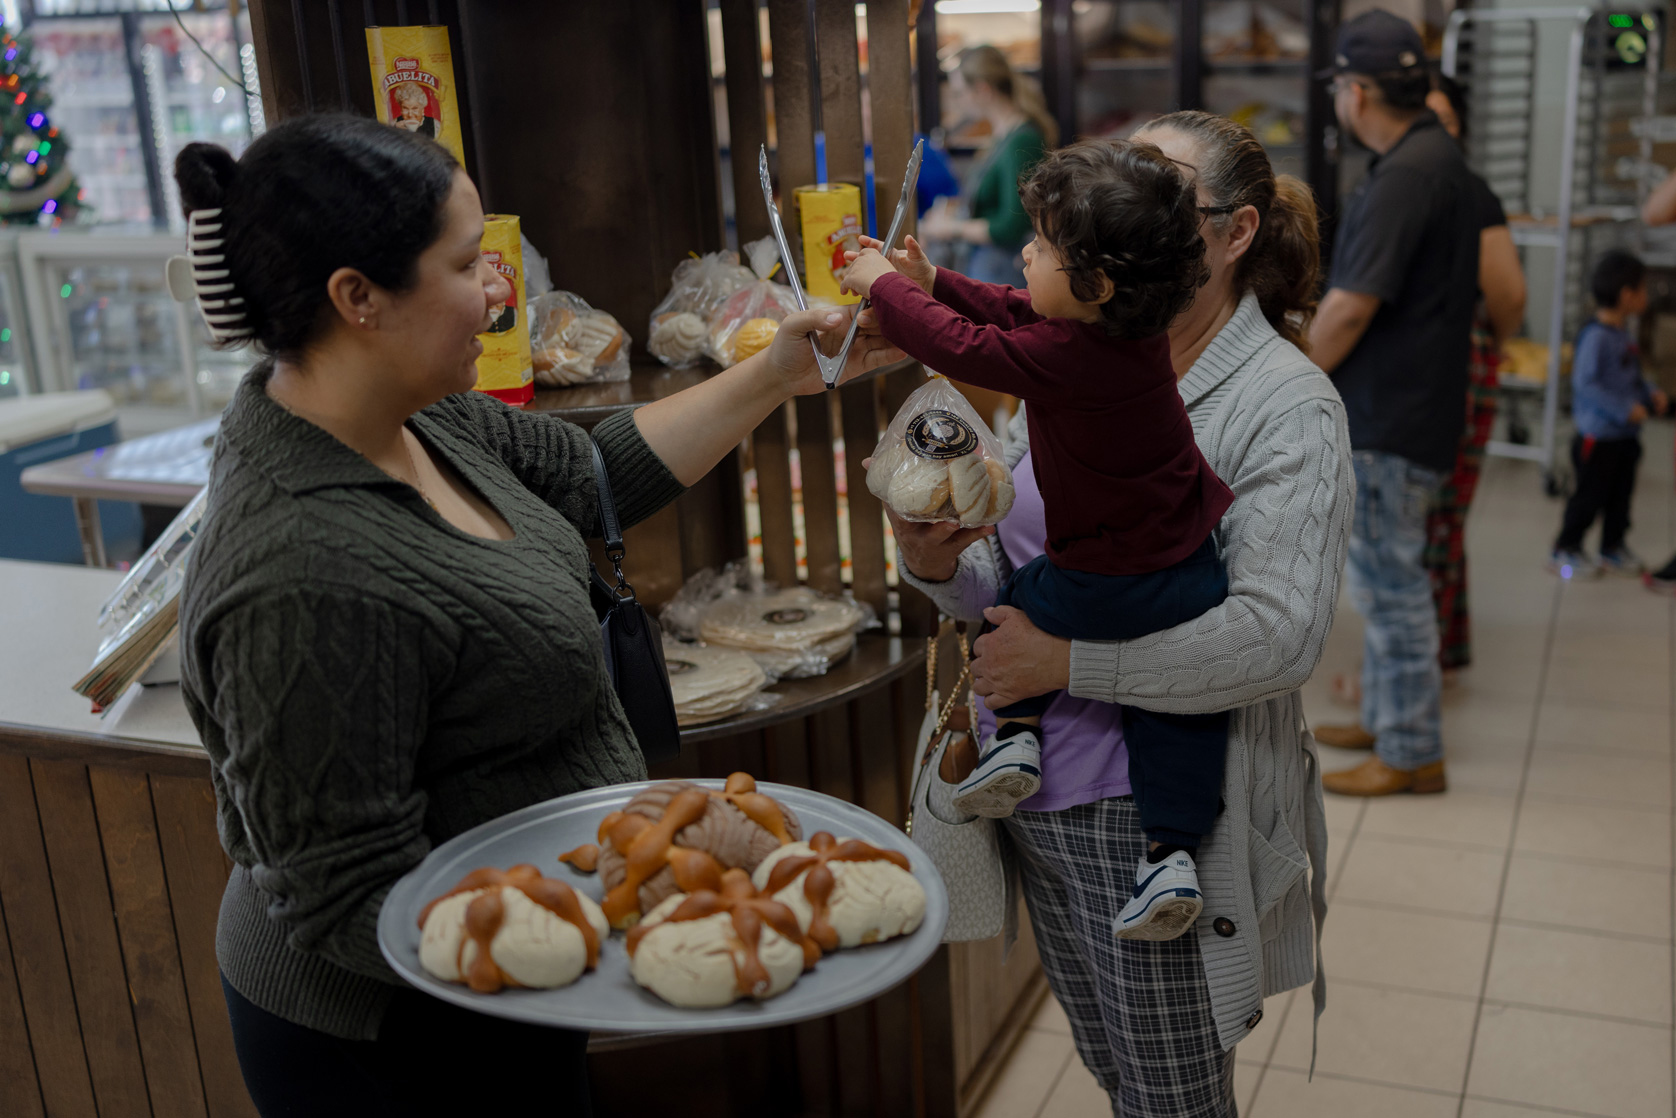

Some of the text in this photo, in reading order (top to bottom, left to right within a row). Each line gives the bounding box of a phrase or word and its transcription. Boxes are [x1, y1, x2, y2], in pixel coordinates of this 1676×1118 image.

[384, 71, 435, 88] ABUELITA
[1025, 738, 1036, 747] NIKE
[1176, 859, 1188, 867] NIKE
